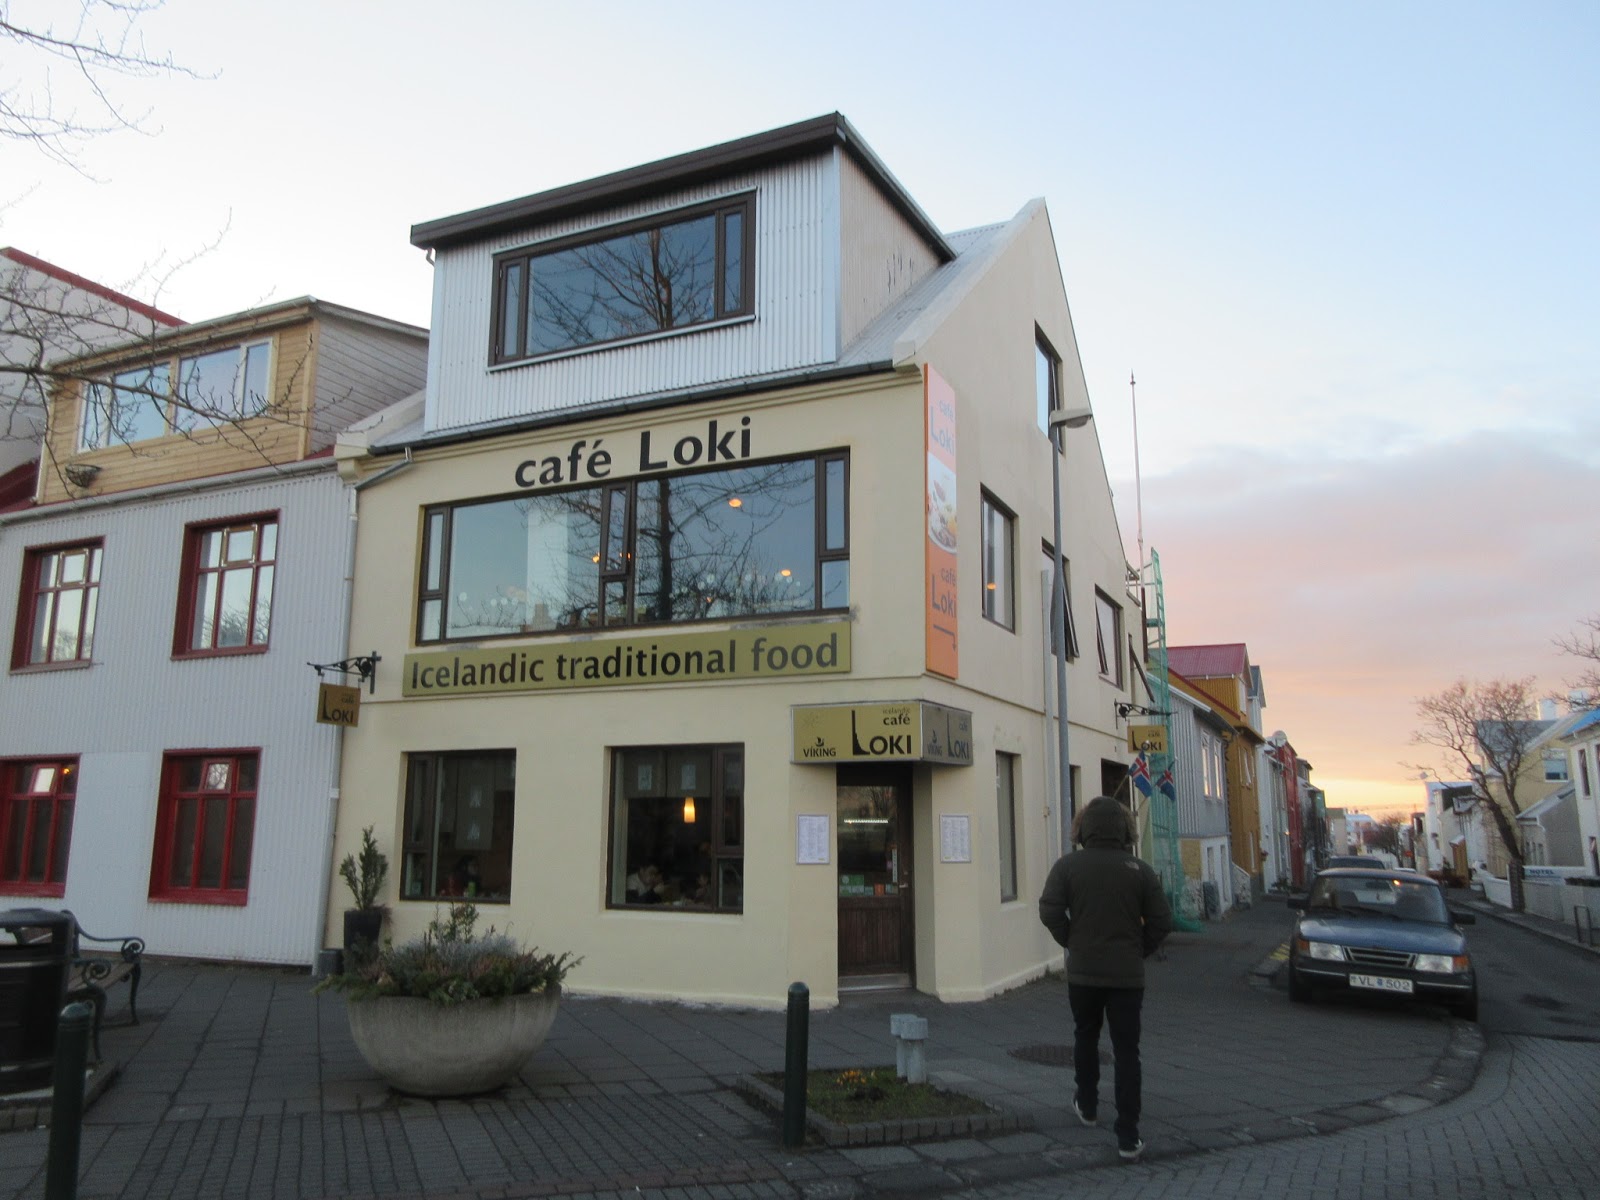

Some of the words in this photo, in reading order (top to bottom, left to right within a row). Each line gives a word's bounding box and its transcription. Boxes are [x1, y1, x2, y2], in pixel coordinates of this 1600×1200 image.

[515, 438, 612, 488] café
[639, 416, 751, 472] Loki
[930, 406, 955, 456] Loki
[931, 574, 956, 618] Loki
[412, 653, 544, 689] Icelandic
[556, 640, 736, 681] traditional
[752, 632, 838, 672] food
[852, 710, 912, 756] LOKI
[883, 713, 911, 726] café
